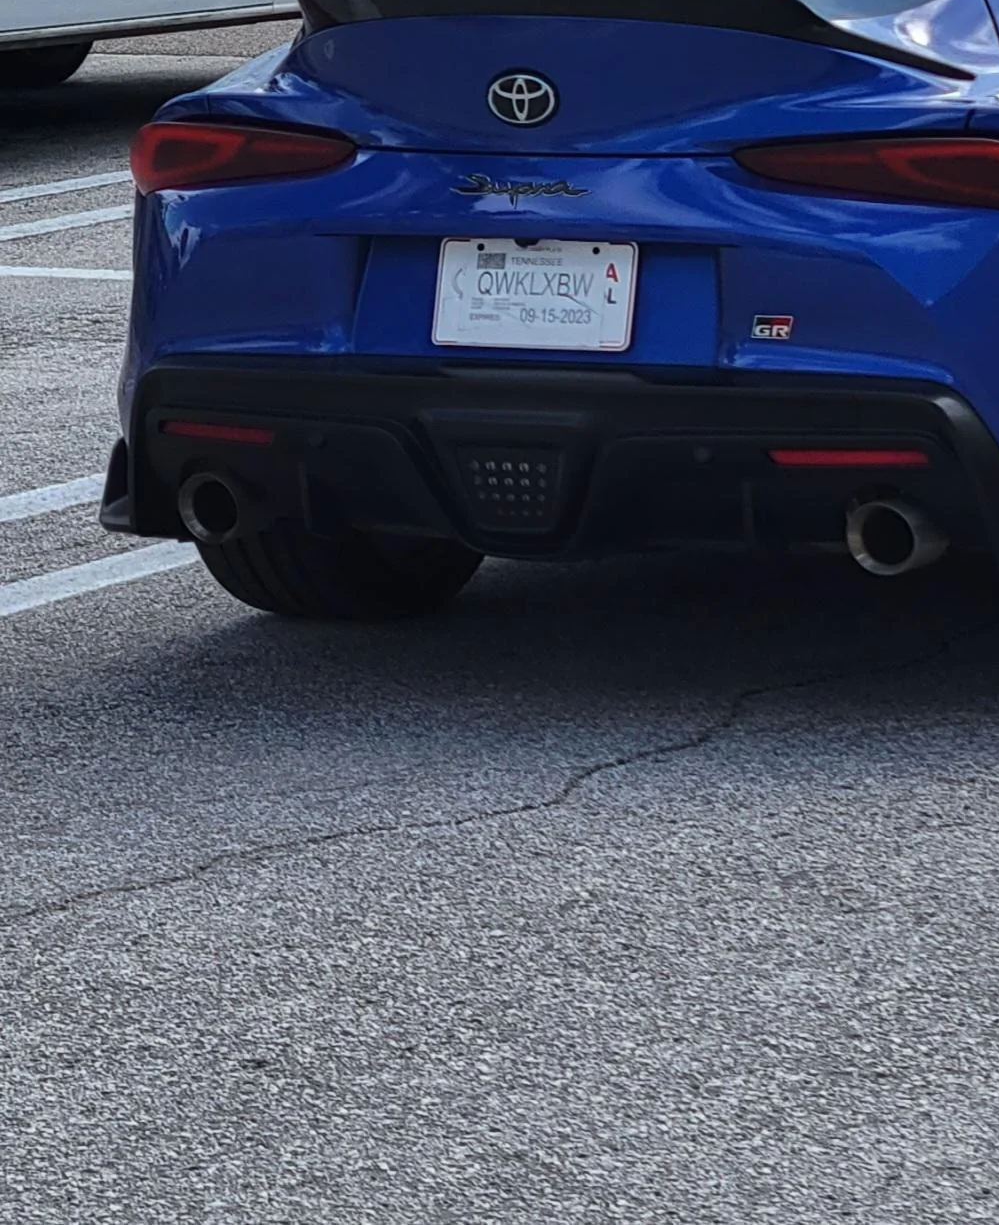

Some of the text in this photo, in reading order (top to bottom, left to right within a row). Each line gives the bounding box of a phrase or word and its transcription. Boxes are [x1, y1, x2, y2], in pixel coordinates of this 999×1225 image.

[450, 173, 593, 210] Supra
[511, 256, 563, 267] TENNESSEE
[477, 271, 594, 297] QWKLXBW
[519, 307, 592, 324] 09-15-2023
[755, 324, 789, 337] GR
